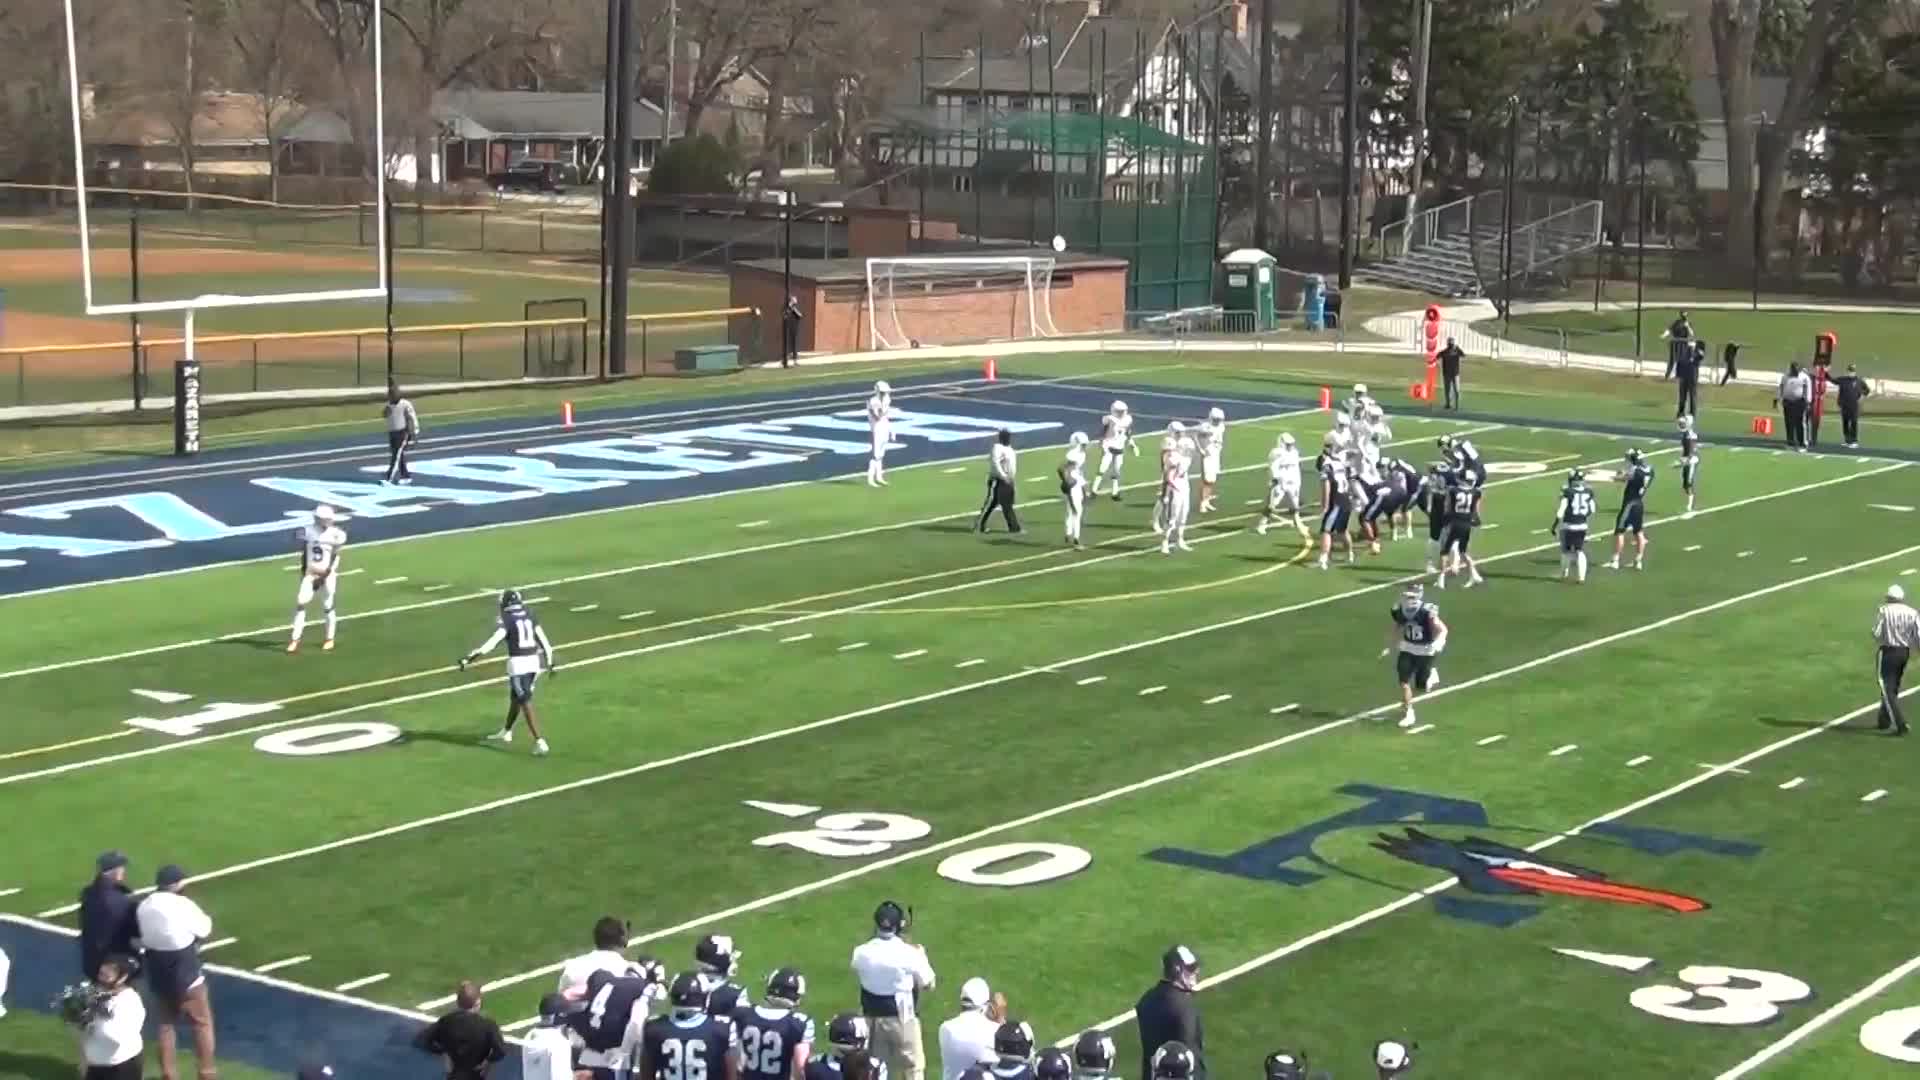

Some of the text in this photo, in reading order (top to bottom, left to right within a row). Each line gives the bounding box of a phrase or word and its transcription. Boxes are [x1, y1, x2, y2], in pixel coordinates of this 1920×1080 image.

[1454, 492, 1473, 514] 21
[1570, 493, 1589, 515] 45
[515, 619, 536, 648] 11
[589, 981, 616, 1029] 4
[660, 1038, 708, 1080] 36
[741, 1026, 784, 1075] 32
